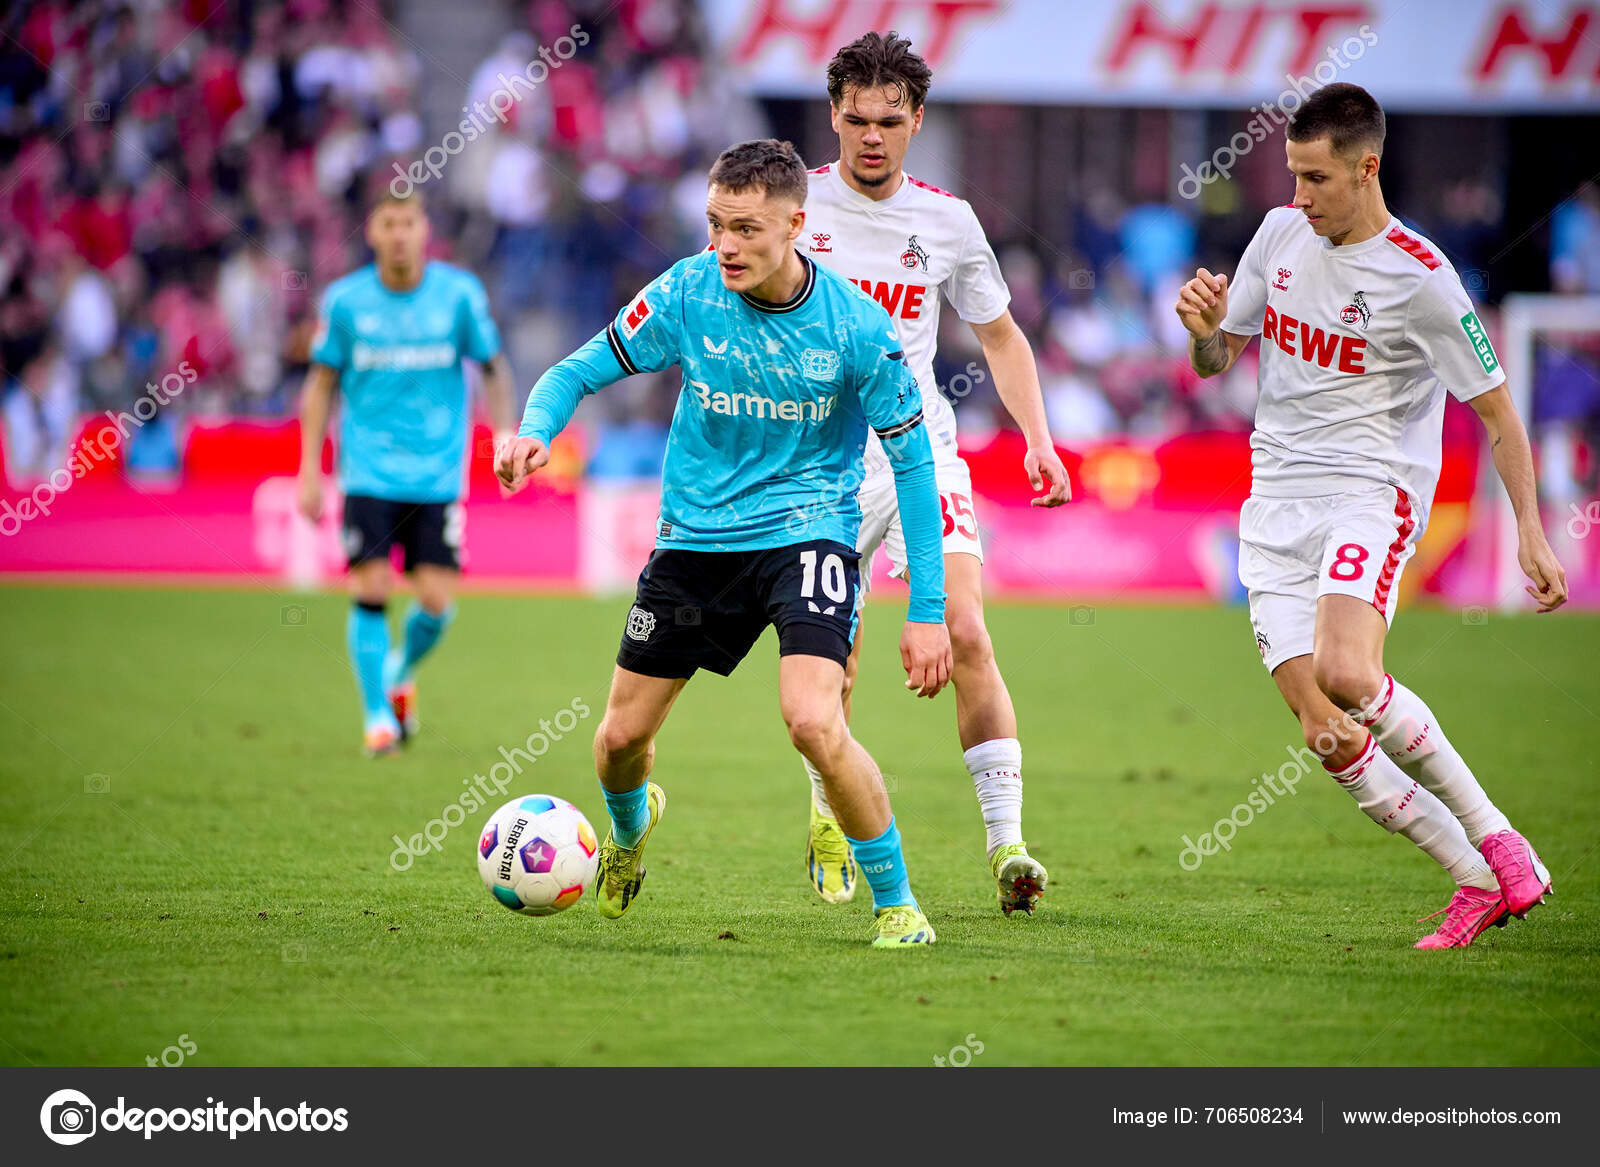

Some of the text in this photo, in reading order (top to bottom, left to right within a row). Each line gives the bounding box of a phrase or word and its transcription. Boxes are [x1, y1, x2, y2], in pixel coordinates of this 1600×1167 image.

[1106, 3, 1372, 76] HIT
[1472, 7, 1600, 84] H
[848, 278, 926, 319] WE
[1263, 305, 1367, 374] REWE
[1465, 317, 1495, 367] DEVK
[690, 379, 838, 426] Barmenia
[800, 550, 847, 604] 10
[1328, 543, 1369, 581] 8
[500, 818, 528, 881] DERBYSTAR
